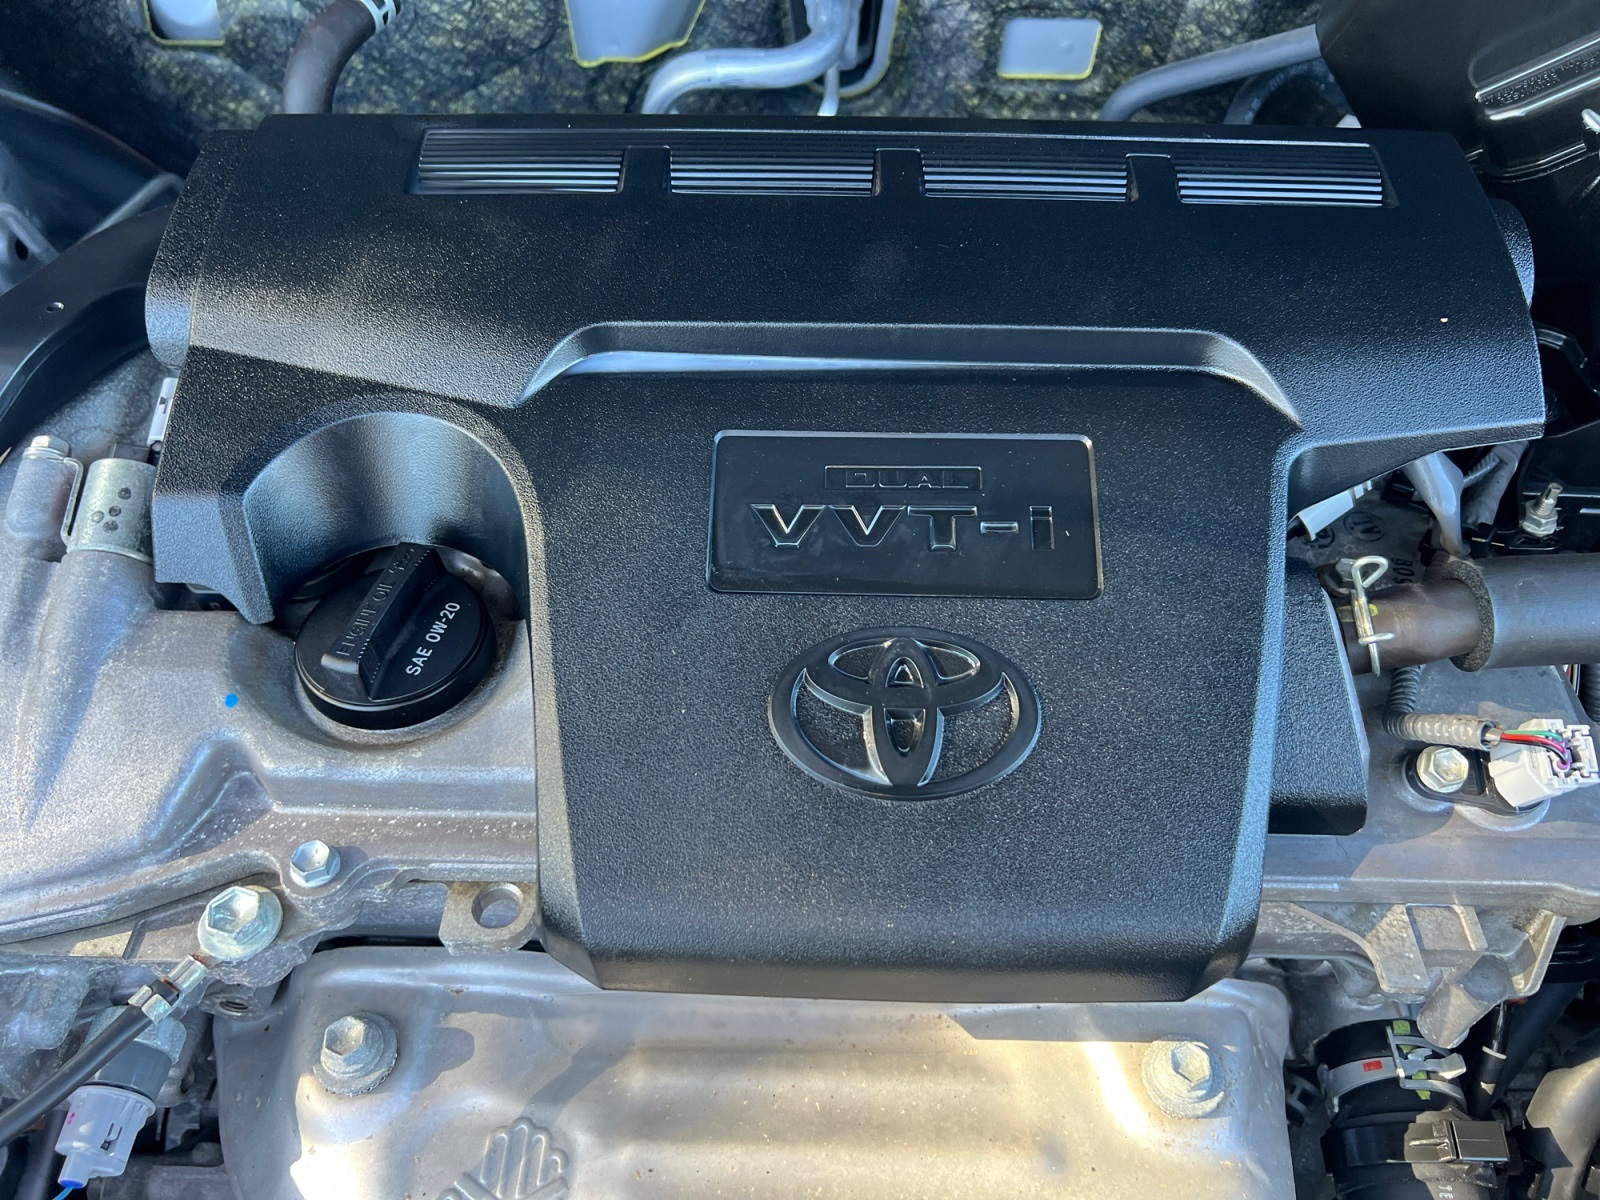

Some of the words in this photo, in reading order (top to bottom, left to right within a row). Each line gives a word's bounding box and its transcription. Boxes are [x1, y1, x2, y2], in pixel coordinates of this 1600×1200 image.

[845, 469, 969, 489] DUAL
[749, 503, 1055, 550] VVT-i
[336, 602, 378, 656] ENGINE
[373, 582, 396, 603] OIL
[405, 646, 433, 676] SAE
[425, 602, 461, 643] 0W-20
